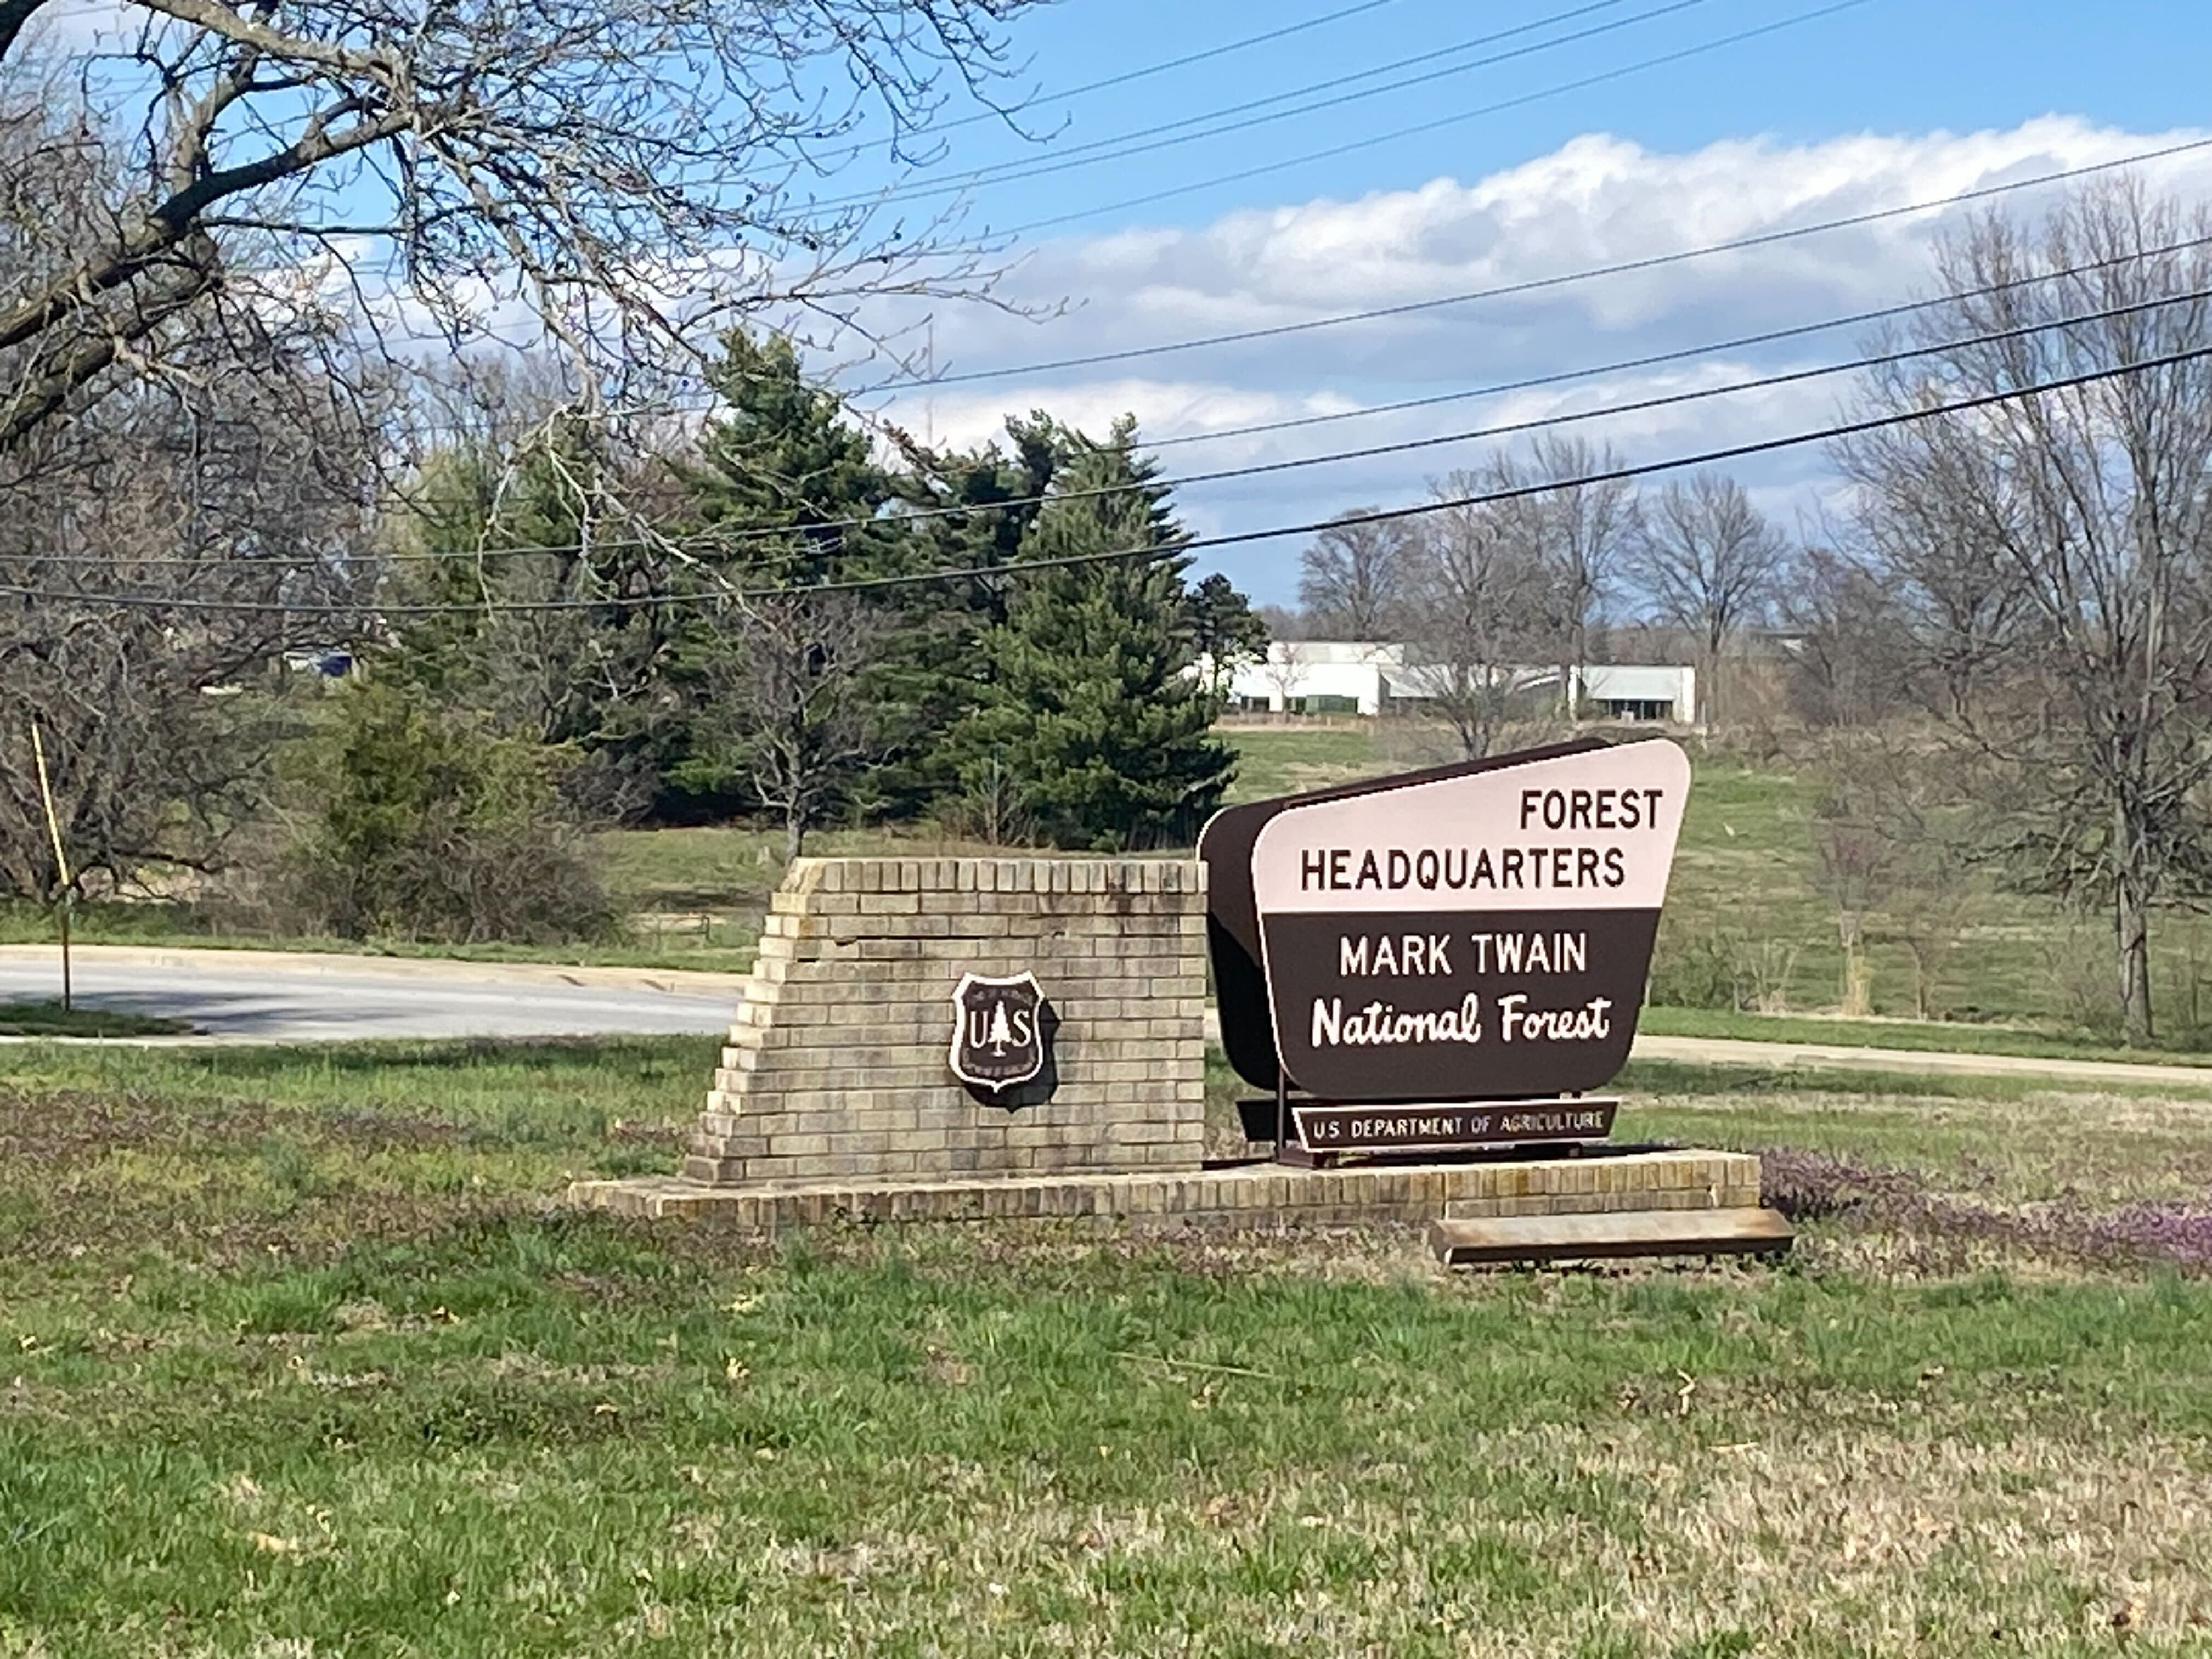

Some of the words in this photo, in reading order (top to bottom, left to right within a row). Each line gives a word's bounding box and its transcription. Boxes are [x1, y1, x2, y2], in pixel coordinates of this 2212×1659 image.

[1520, 789, 1663, 830] FOREST
[1301, 848, 1626, 891] HEADQUARTERS
[1340, 935, 1452, 975] MARK
[1471, 933, 1587, 973] TWAIN
[970, 1011, 988, 1048] U
[1014, 1009, 1031, 1047] S
[1312, 992, 1481, 1047] National
[1498, 994, 1611, 1042] Forest
[1351, 1117, 1462, 1138] DEPARTMENT
[1471, 1115, 1491, 1134] OF
[1500, 1111, 1604, 1132] AGRICULTURE
